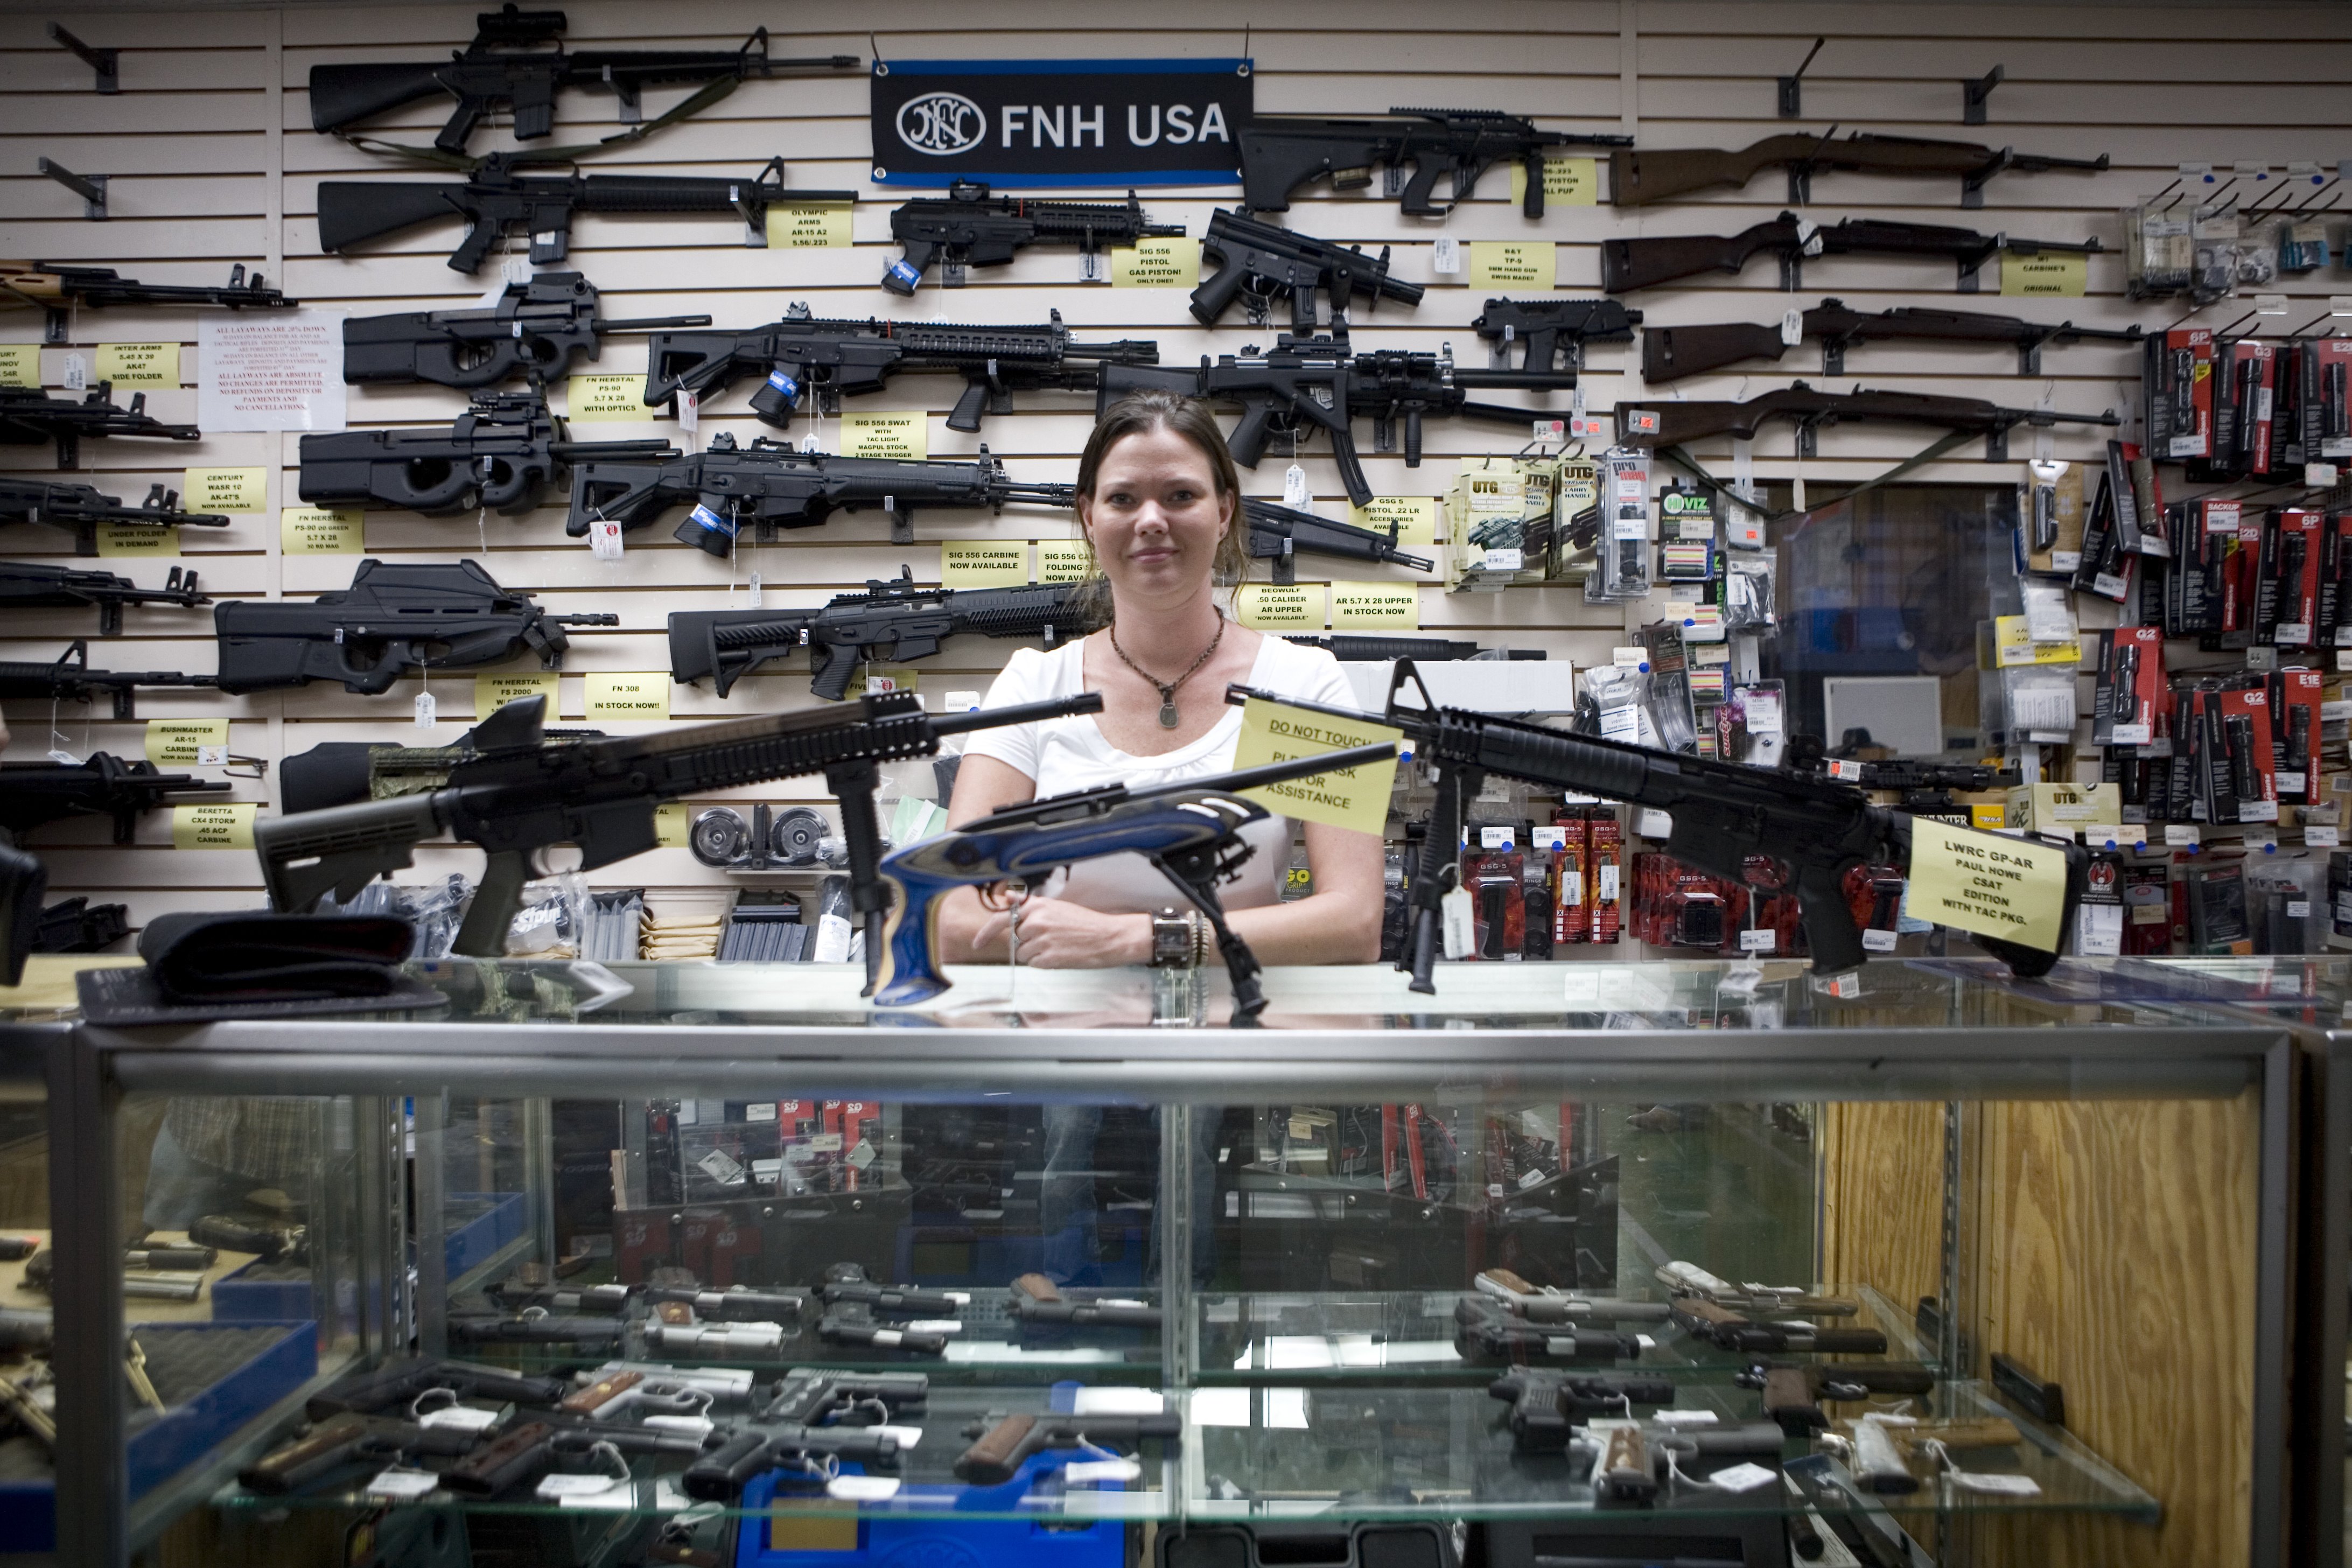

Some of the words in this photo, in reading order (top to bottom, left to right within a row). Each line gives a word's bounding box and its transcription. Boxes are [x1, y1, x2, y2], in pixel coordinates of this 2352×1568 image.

[1000, 105, 1105, 149] FNH
[1128, 102, 1230, 148] USA
[2189, 332, 2209, 343] 6P
[1564, 466, 1593, 479] UTG
[1473, 481, 1498, 493] UTG
[2208, 503, 2240, 511] BACKUP
[702, 515, 719, 529] SAUER
[2301, 515, 2320, 526] 6P
[2136, 628, 2157, 640] G2
[2299, 674, 2321, 685] E1E
[2243, 691, 2265, 703] G2
[1270, 719, 1290, 733] DO
[1293, 724, 1322, 739] NOT
[1266, 783, 1352, 809] ASSISTANCE
[2053, 792, 2077, 804] UTG
[1944, 840, 1985, 859] LWRC
[1990, 851, 2034, 870] GP-AR
[1956, 858, 1985, 873] PAUL
[1989, 866, 2022, 881] HOWE
[1972, 876, 2003, 891] CSAT
[1963, 888, 2010, 907] EDITION
[1942, 898, 1972, 913] WITH
[1975, 905, 1998, 919] TAC
[1999, 911, 2027, 926] PKG.
